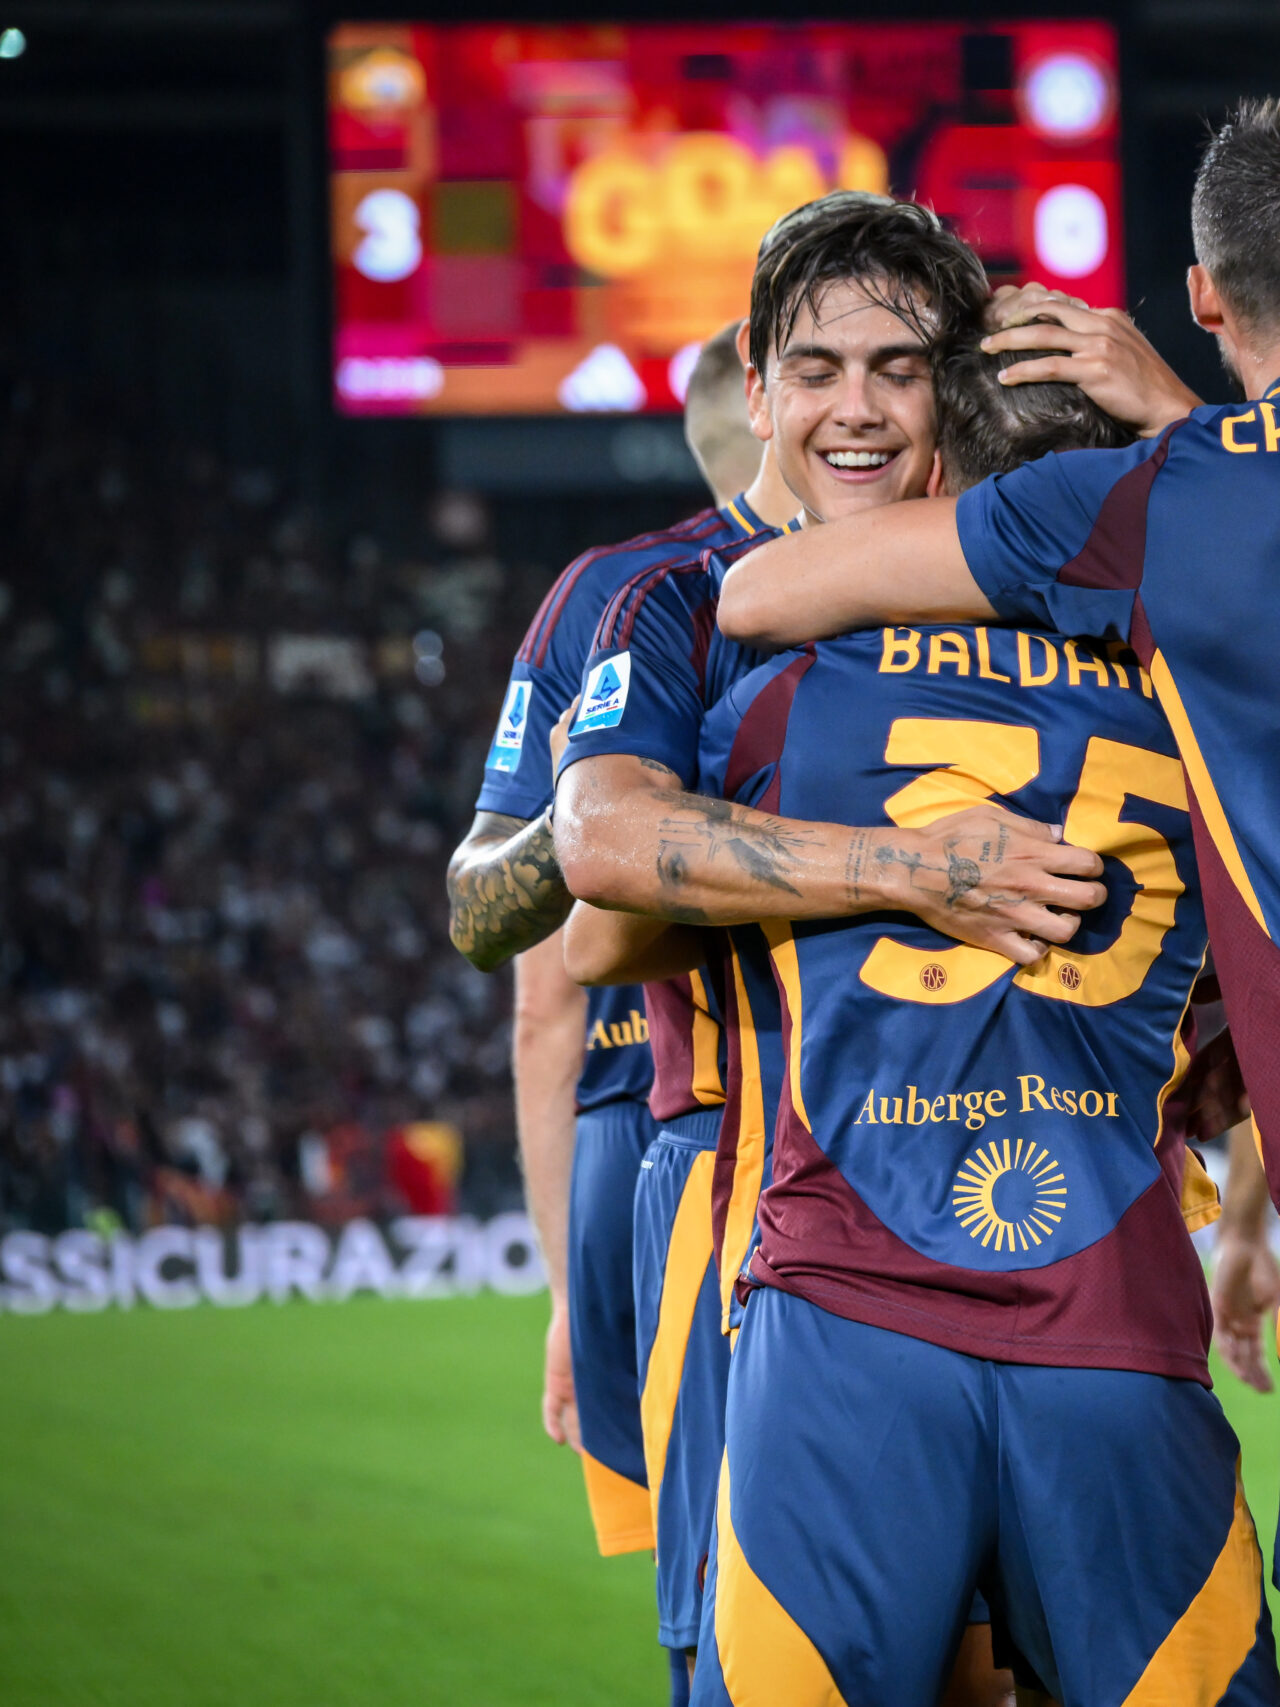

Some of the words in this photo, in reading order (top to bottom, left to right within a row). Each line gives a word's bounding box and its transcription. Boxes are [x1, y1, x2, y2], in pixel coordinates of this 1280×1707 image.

[353, 190, 422, 281] 3
[586, 700, 611, 714] SERIE
[858, 717, 1190, 1007] 35
[854, 1085, 1008, 1130] Auberge
